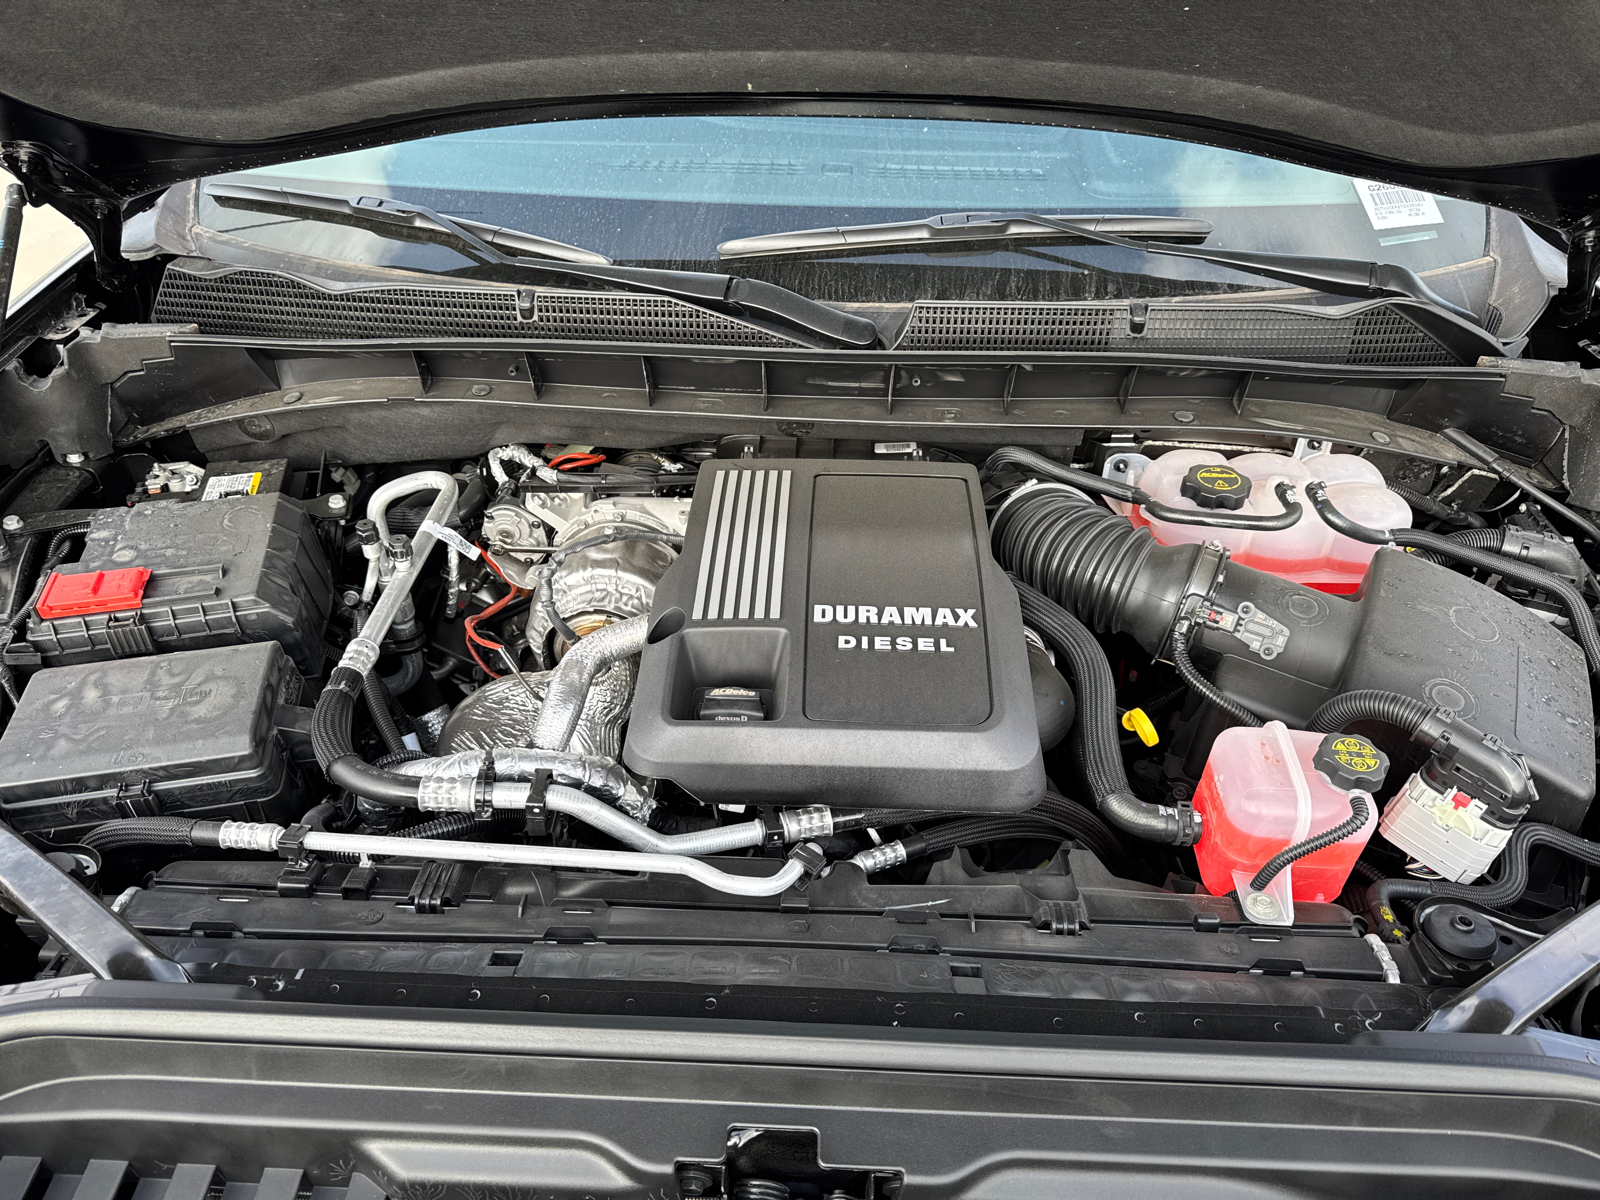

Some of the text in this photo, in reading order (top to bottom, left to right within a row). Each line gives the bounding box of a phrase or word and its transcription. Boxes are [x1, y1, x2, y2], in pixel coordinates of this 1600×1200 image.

[813, 604, 978, 628] DURAMAX
[838, 635, 955, 653] DIESEL
[710, 688, 756, 697] ACDelco
